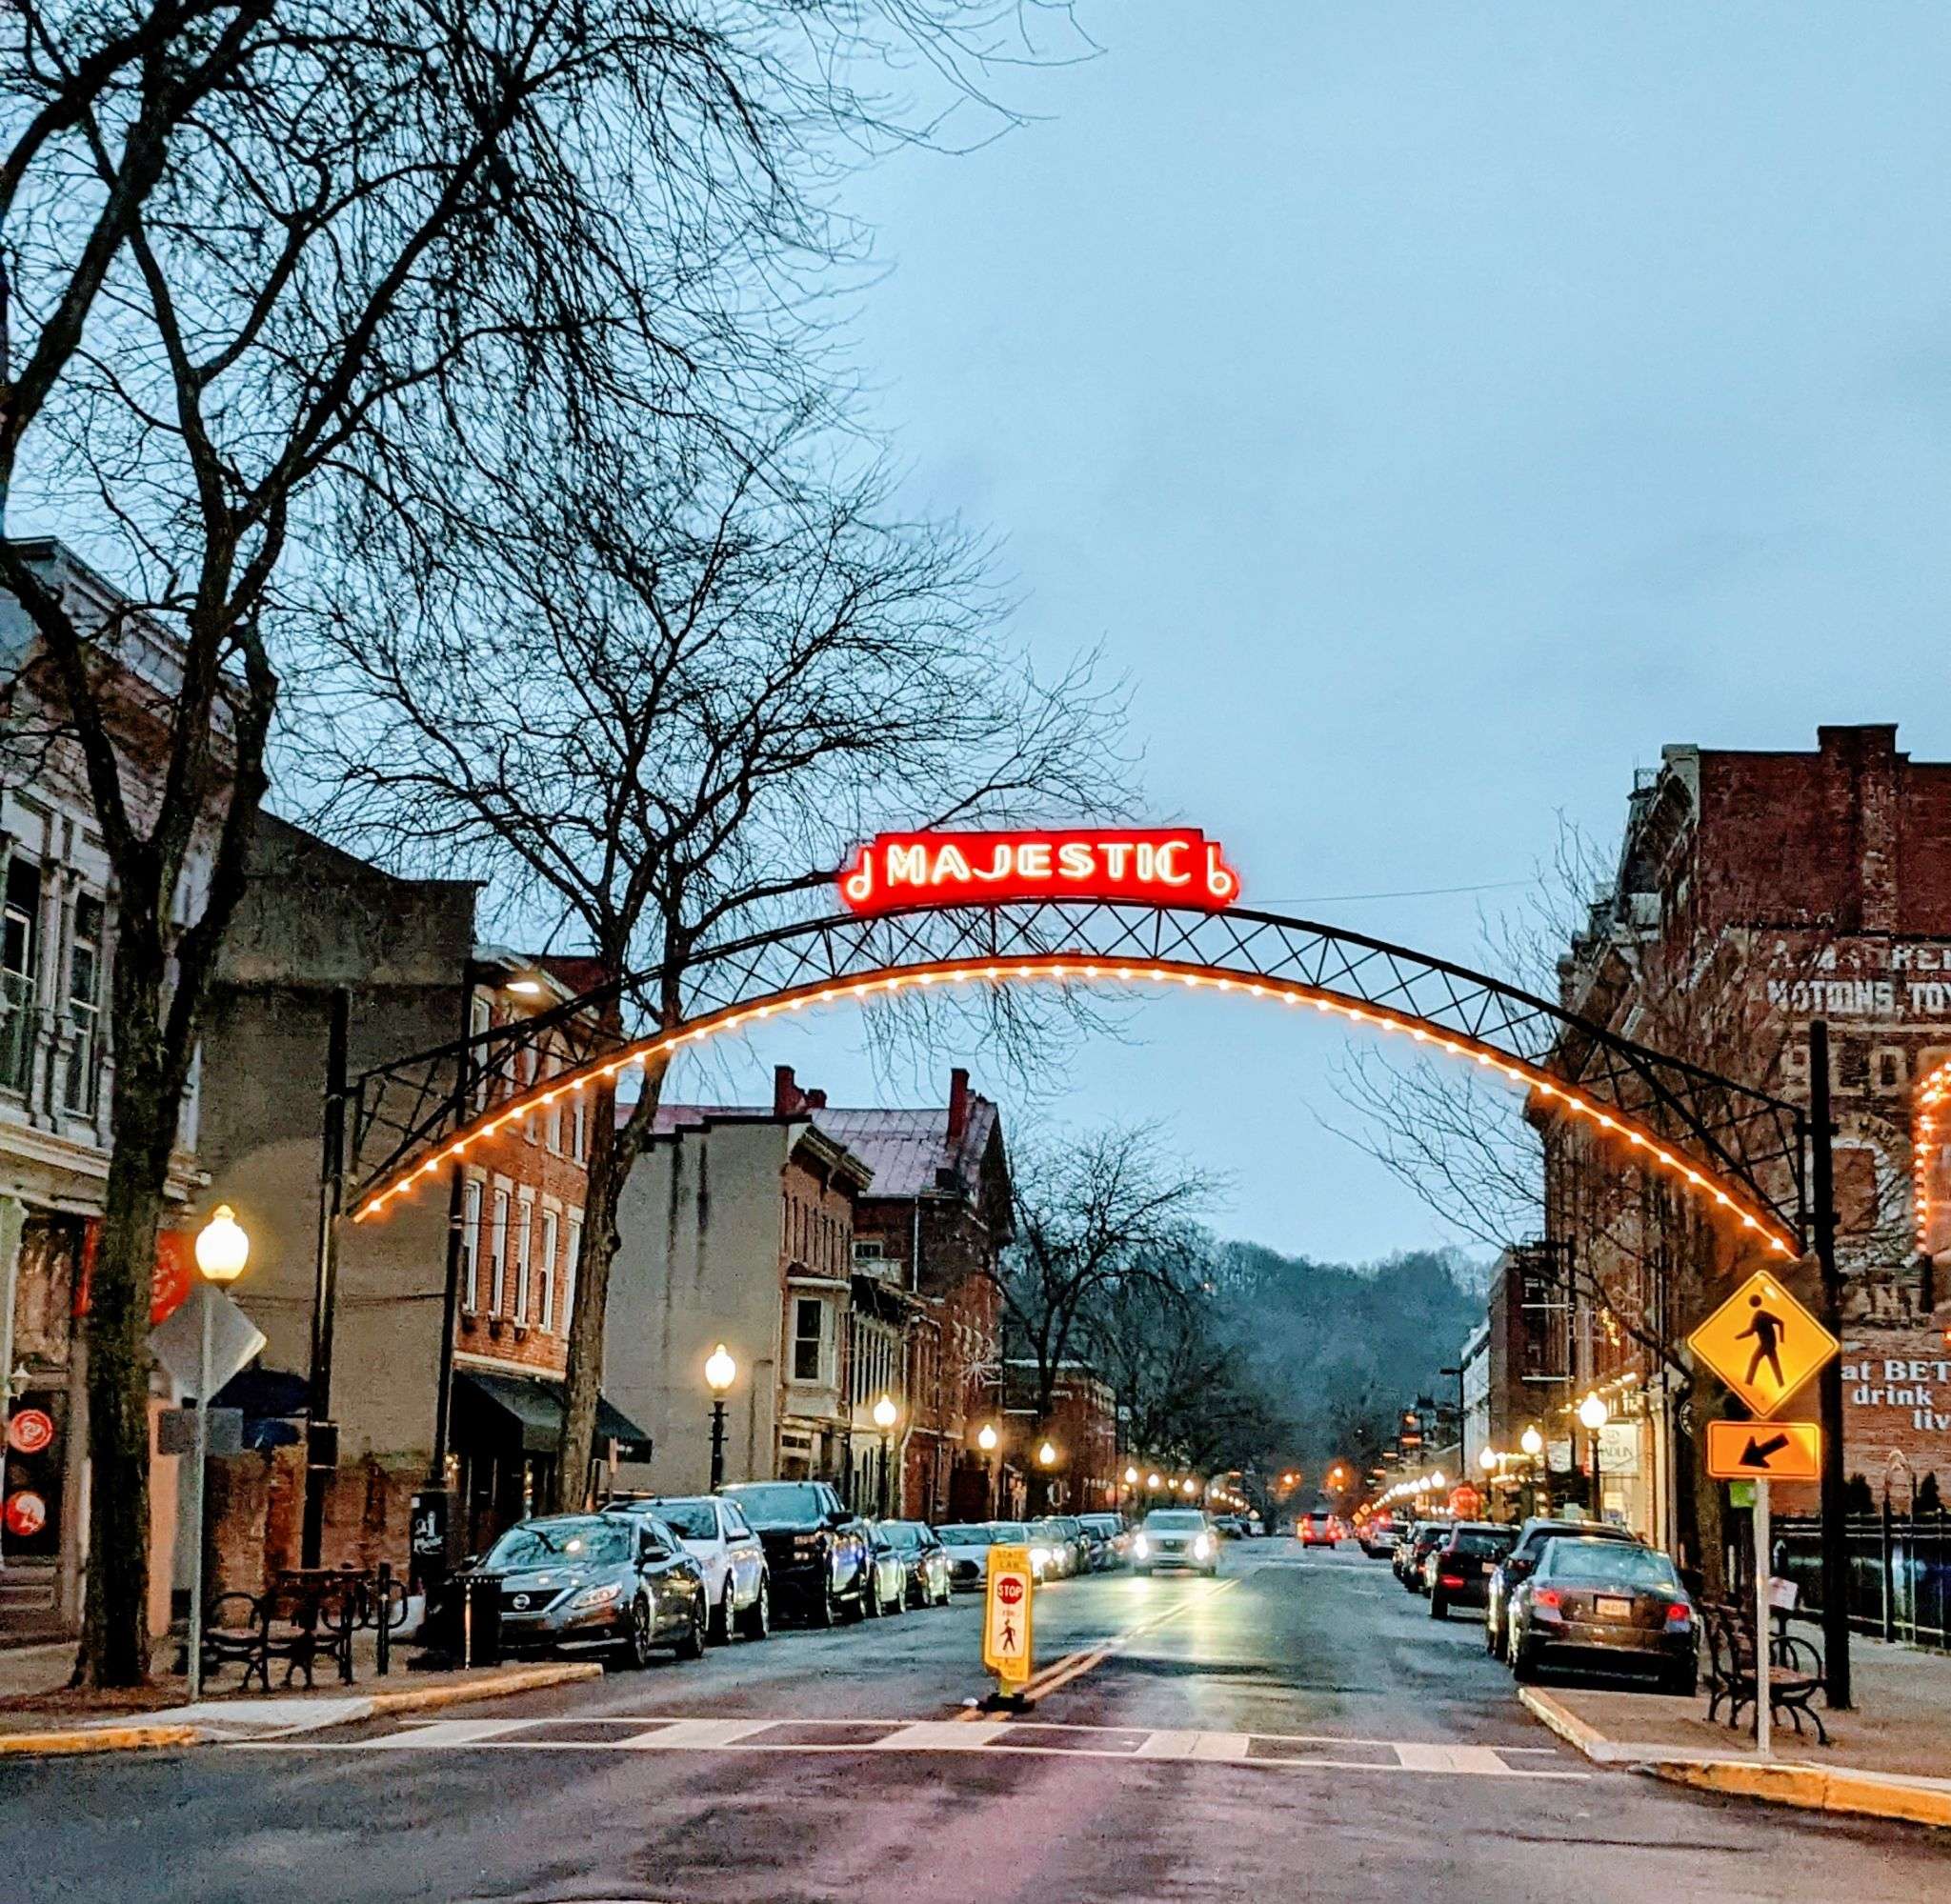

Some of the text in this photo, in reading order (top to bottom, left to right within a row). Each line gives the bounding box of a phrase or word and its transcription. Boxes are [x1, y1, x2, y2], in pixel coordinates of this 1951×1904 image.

[886, 840, 1192, 887] MAJESTIC
[1841, 1362, 1871, 1381] at
[1853, 1384, 1935, 1406] drink
[997, 1584, 1023, 1598] STOP
